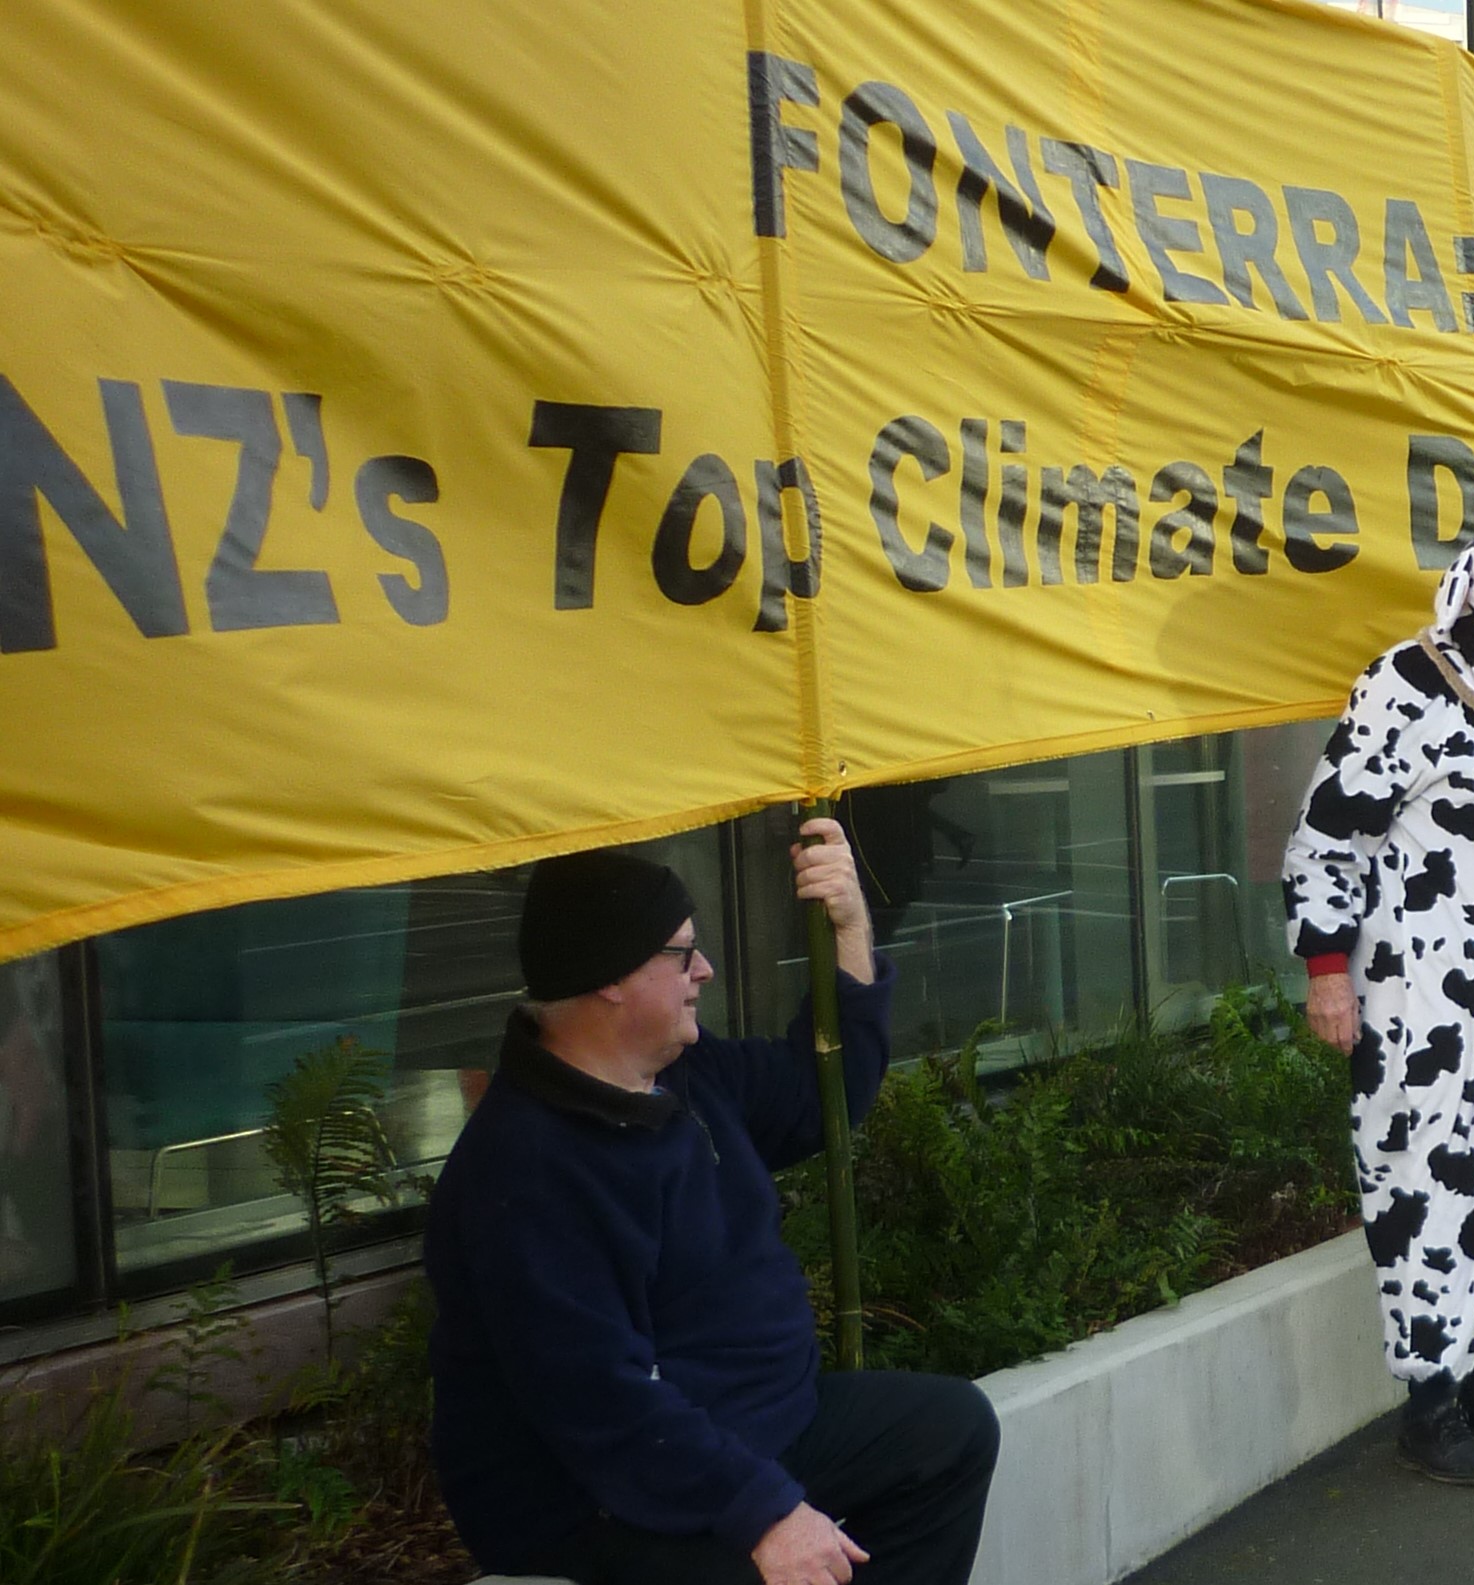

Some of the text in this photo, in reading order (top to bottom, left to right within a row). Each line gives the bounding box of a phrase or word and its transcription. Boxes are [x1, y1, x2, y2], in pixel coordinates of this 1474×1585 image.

[0, 372, 449, 653] NZ's
[527, 399, 822, 633] Top
[869, 413, 1359, 592] Climate
